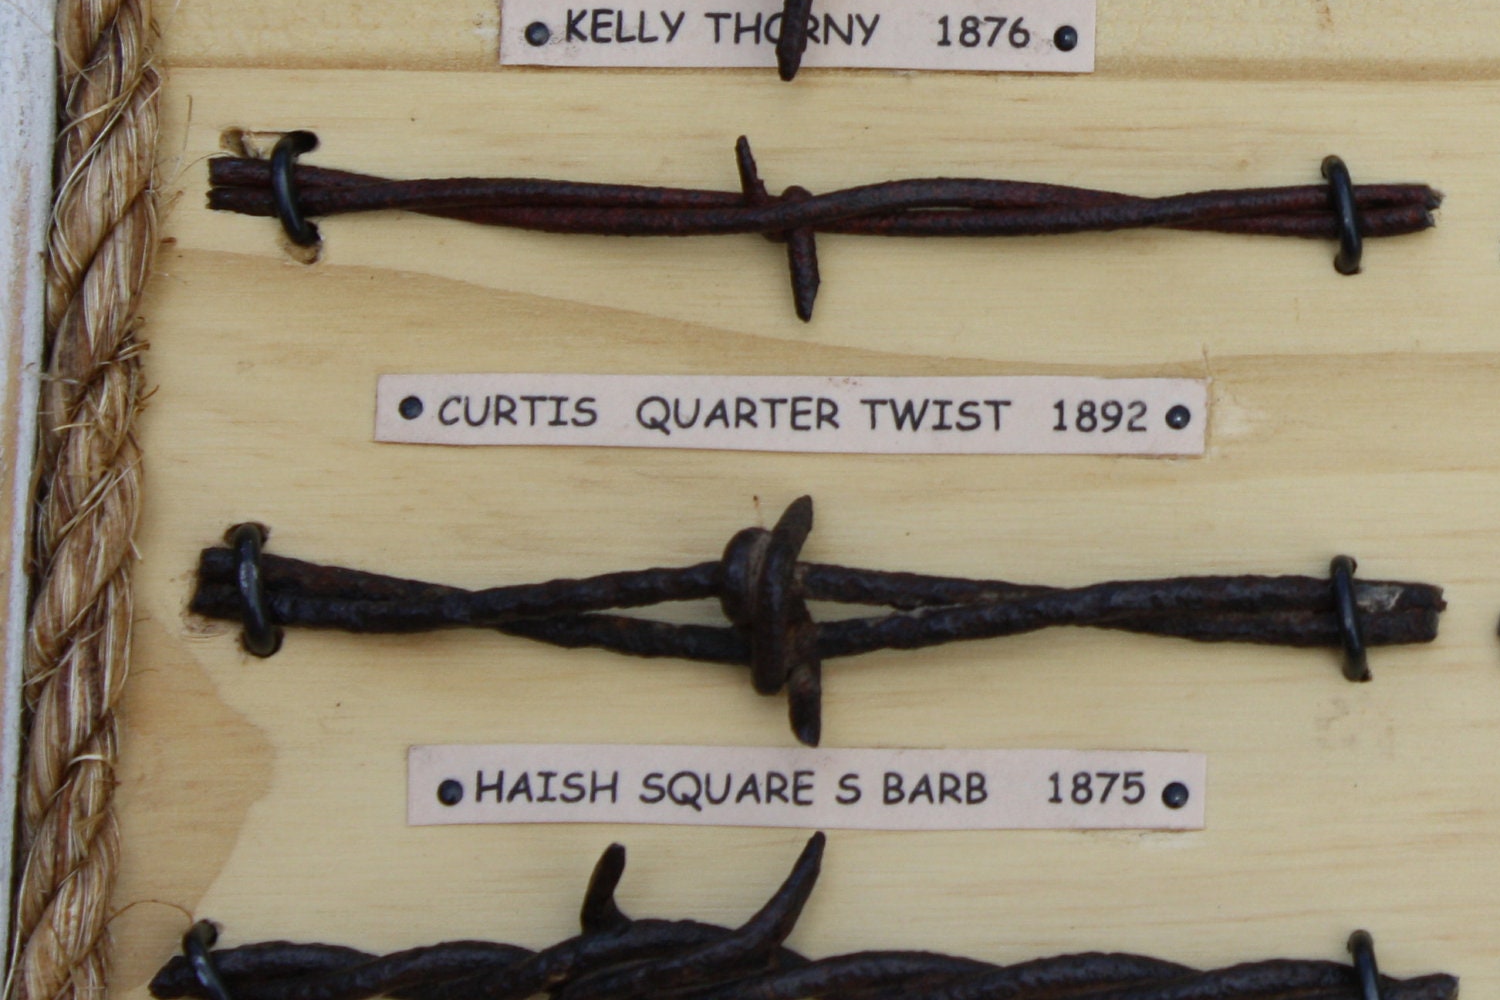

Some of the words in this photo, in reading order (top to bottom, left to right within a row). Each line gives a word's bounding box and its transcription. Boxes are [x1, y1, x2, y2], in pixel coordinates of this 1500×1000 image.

[565, 8, 686, 44] KELLY
[937, 15, 1031, 49] 1876
[437, 394, 598, 428] CURTIS
[636, 395, 840, 436] QUARTER
[860, 399, 1012, 432] TWIST
[1053, 399, 1147, 433] 1892
[475, 770, 619, 804] HAISH
[639, 770, 815, 812] SQUARE
[835, 773, 862, 806] S
[882, 771, 988, 806] BARB
[1048, 771, 1146, 806] 1875
